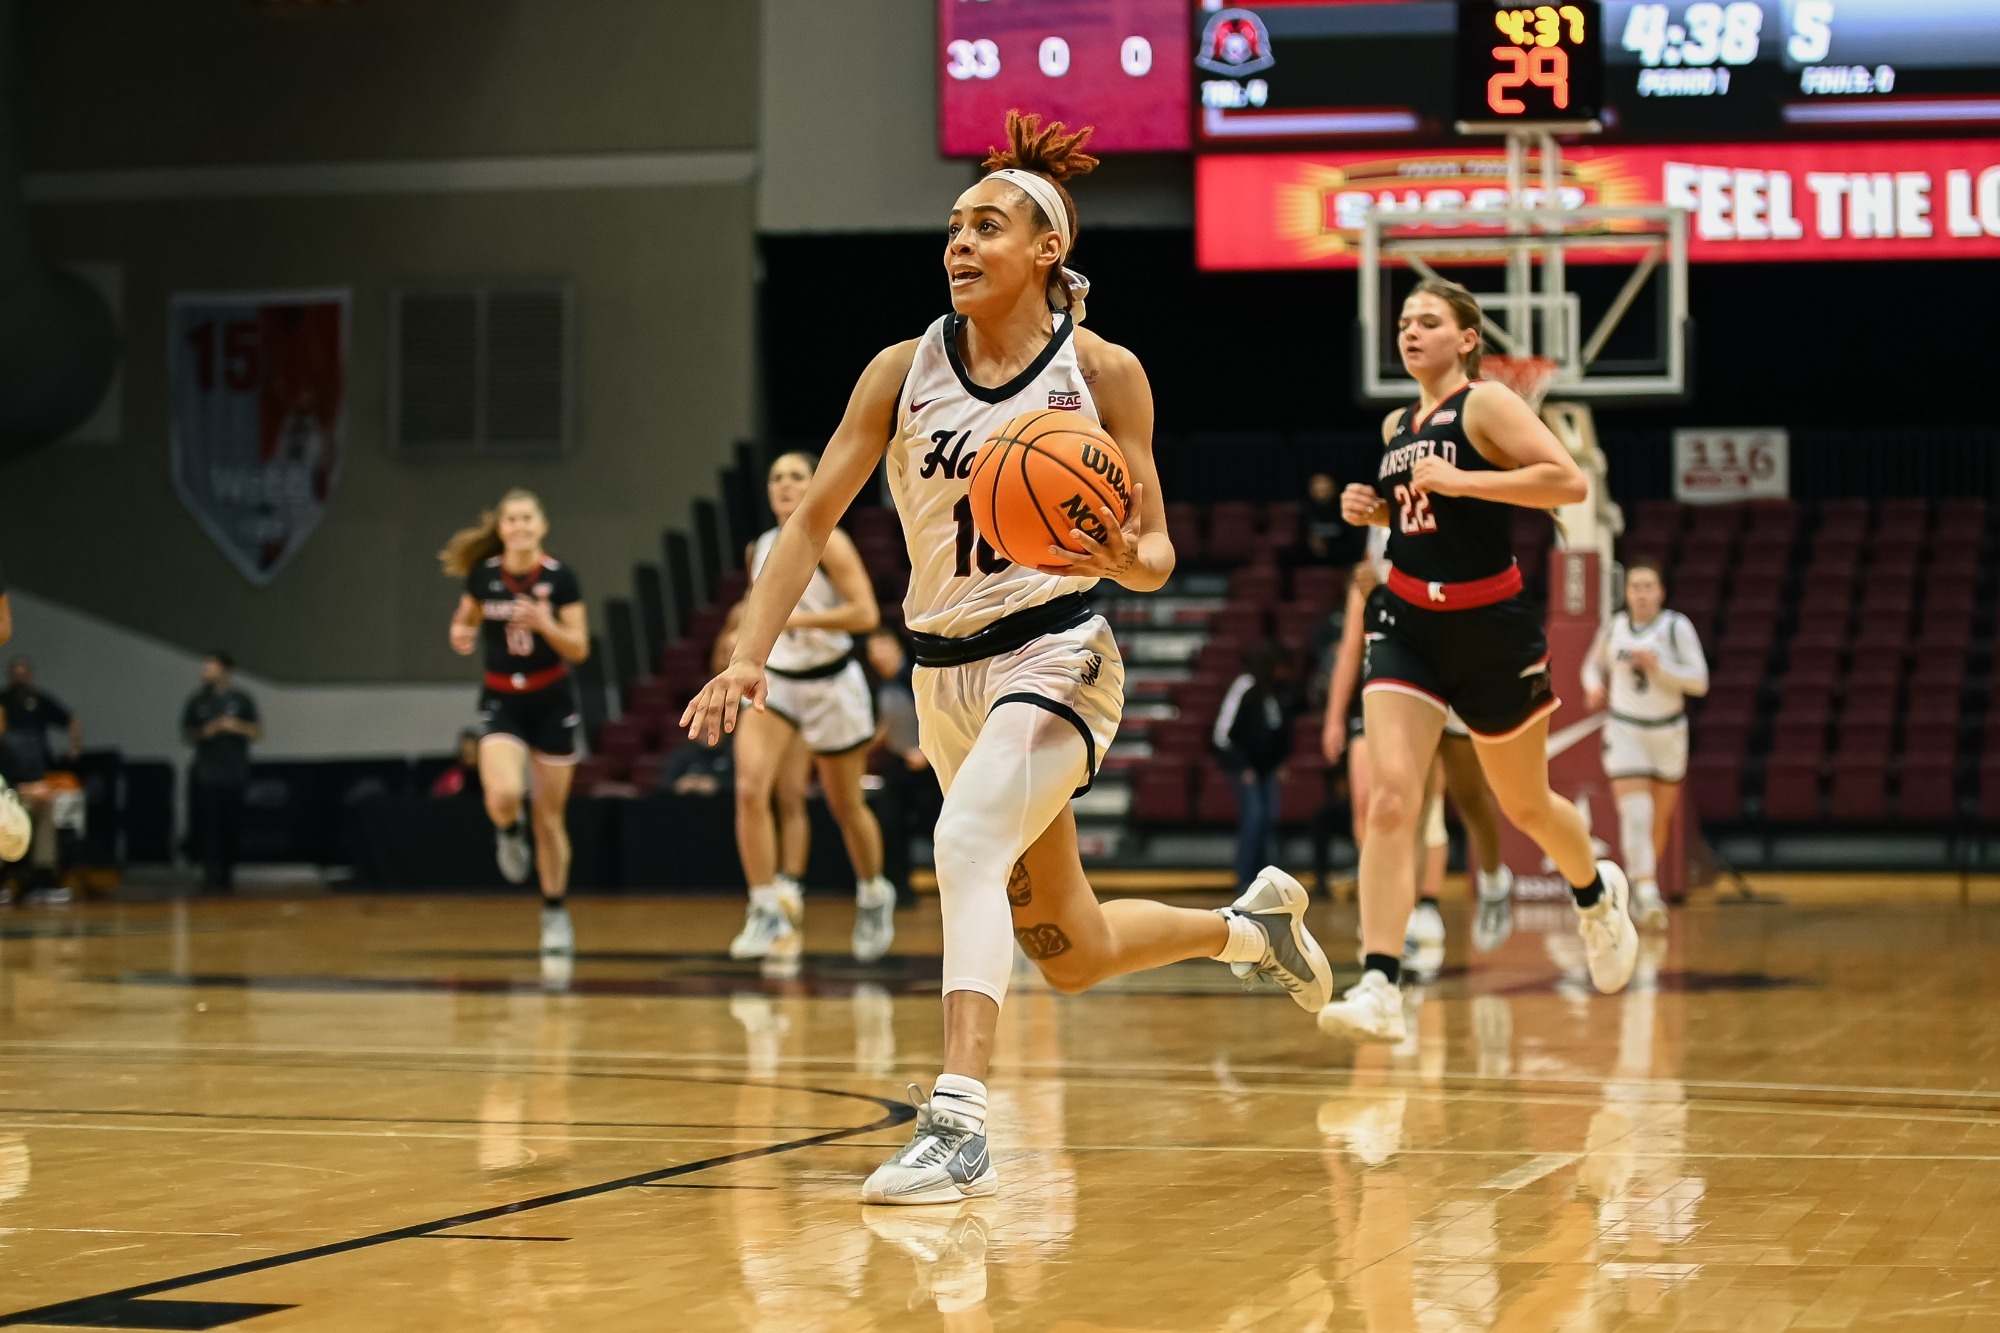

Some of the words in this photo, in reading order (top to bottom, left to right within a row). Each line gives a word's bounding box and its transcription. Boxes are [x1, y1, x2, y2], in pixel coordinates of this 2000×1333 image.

[1496, 6, 1584, 47] 4:37
[1622, 3, 1763, 66] 4:38
[947, 39, 1000, 80] 33
[1038, 36, 1070, 77] 0
[1120, 36, 1153, 77] 0
[1488, 46, 1568, 114] 29
[1663, 162, 1802, 240] FEEL
[1808, 172, 1932, 238] THE
[187, 319, 258, 392] 15
[1047, 394, 1082, 406] PSAC
[1060, 493, 1108, 545] NCA
[1394, 483, 1438, 536] 22
